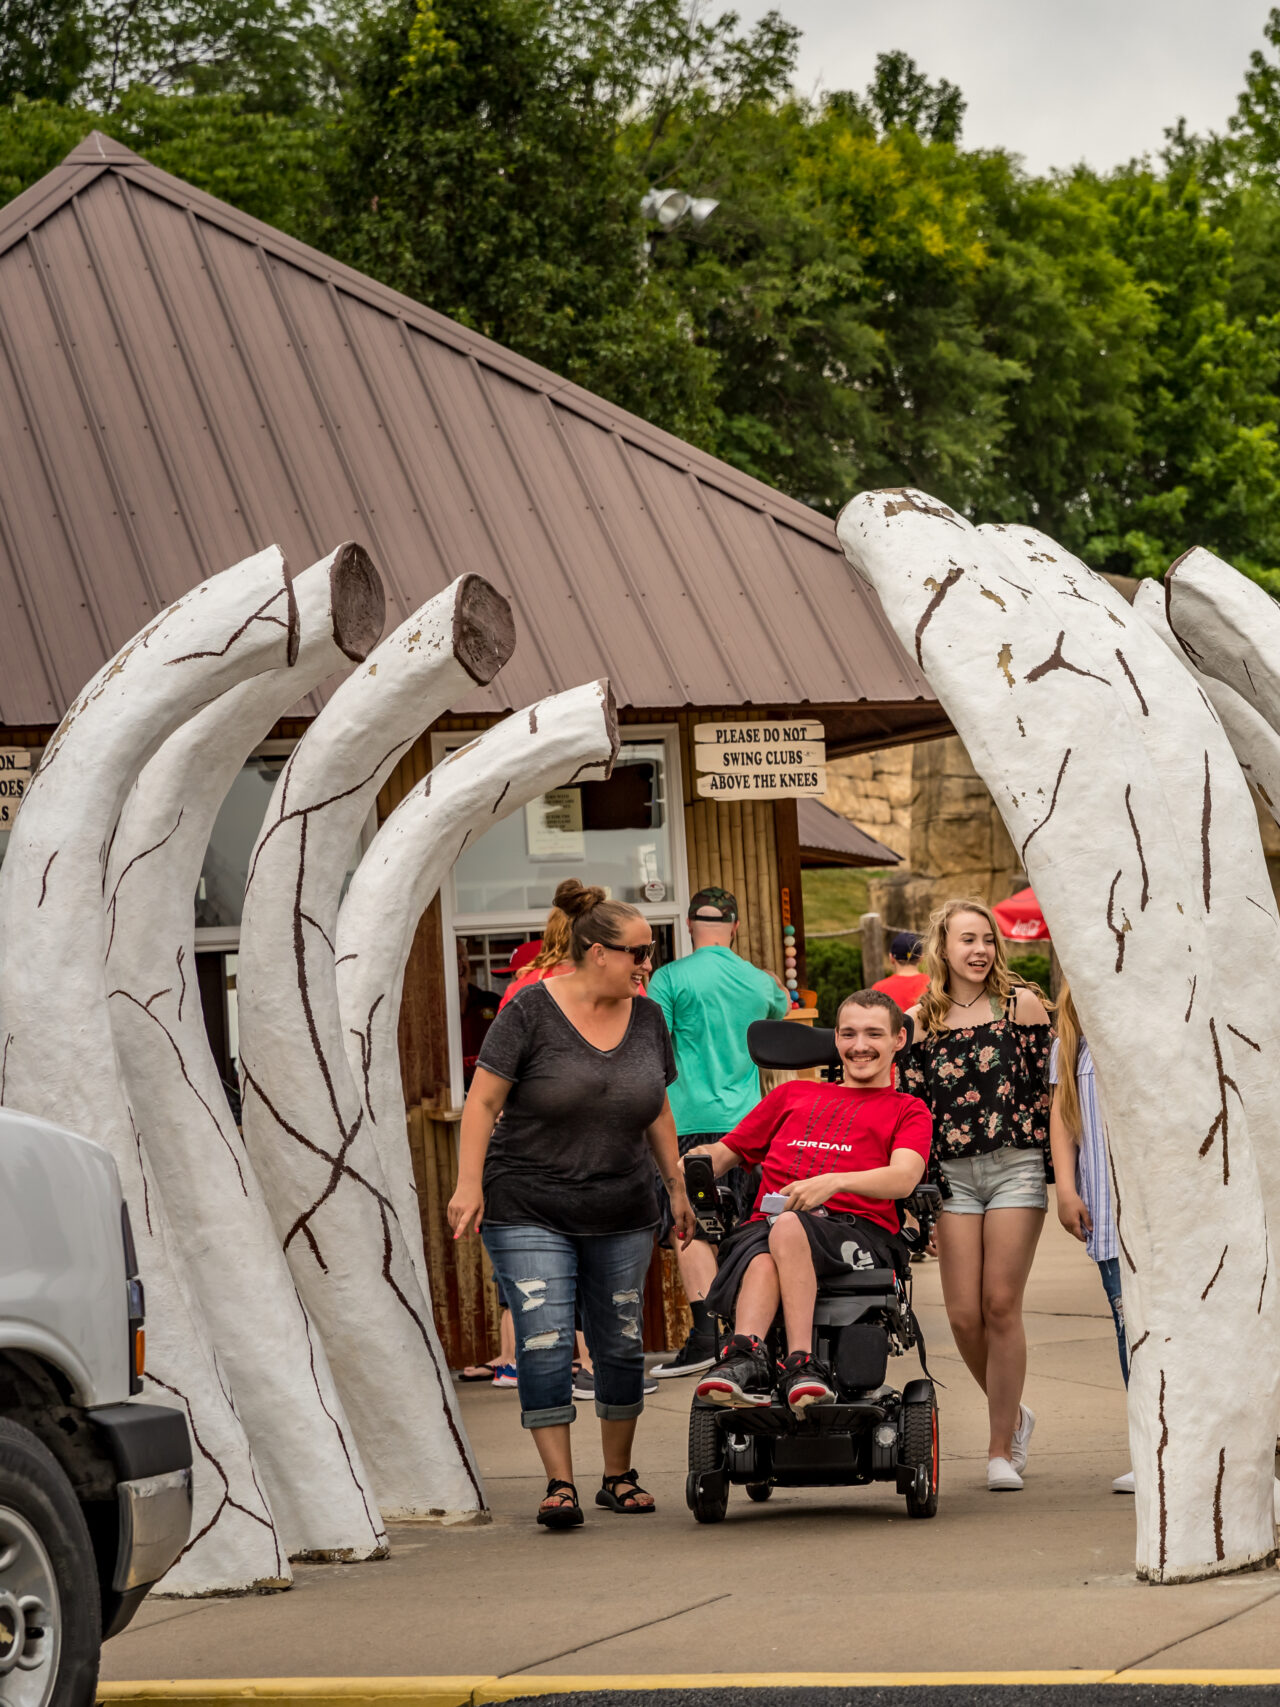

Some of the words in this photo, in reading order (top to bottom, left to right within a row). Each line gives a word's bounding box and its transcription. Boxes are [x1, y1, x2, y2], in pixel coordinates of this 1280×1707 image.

[716, 728, 760, 743] PLEASE
[763, 728, 780, 742] DO
[783, 727, 808, 741] NOT
[723, 751, 762, 766] SWING
[766, 750, 803, 765] CLUBS
[710, 774, 750, 790] ABOVE
[753, 773, 776, 788] THE
[780, 772, 818, 788] KNEES
[787, 1139, 853, 1152] JORDAN
